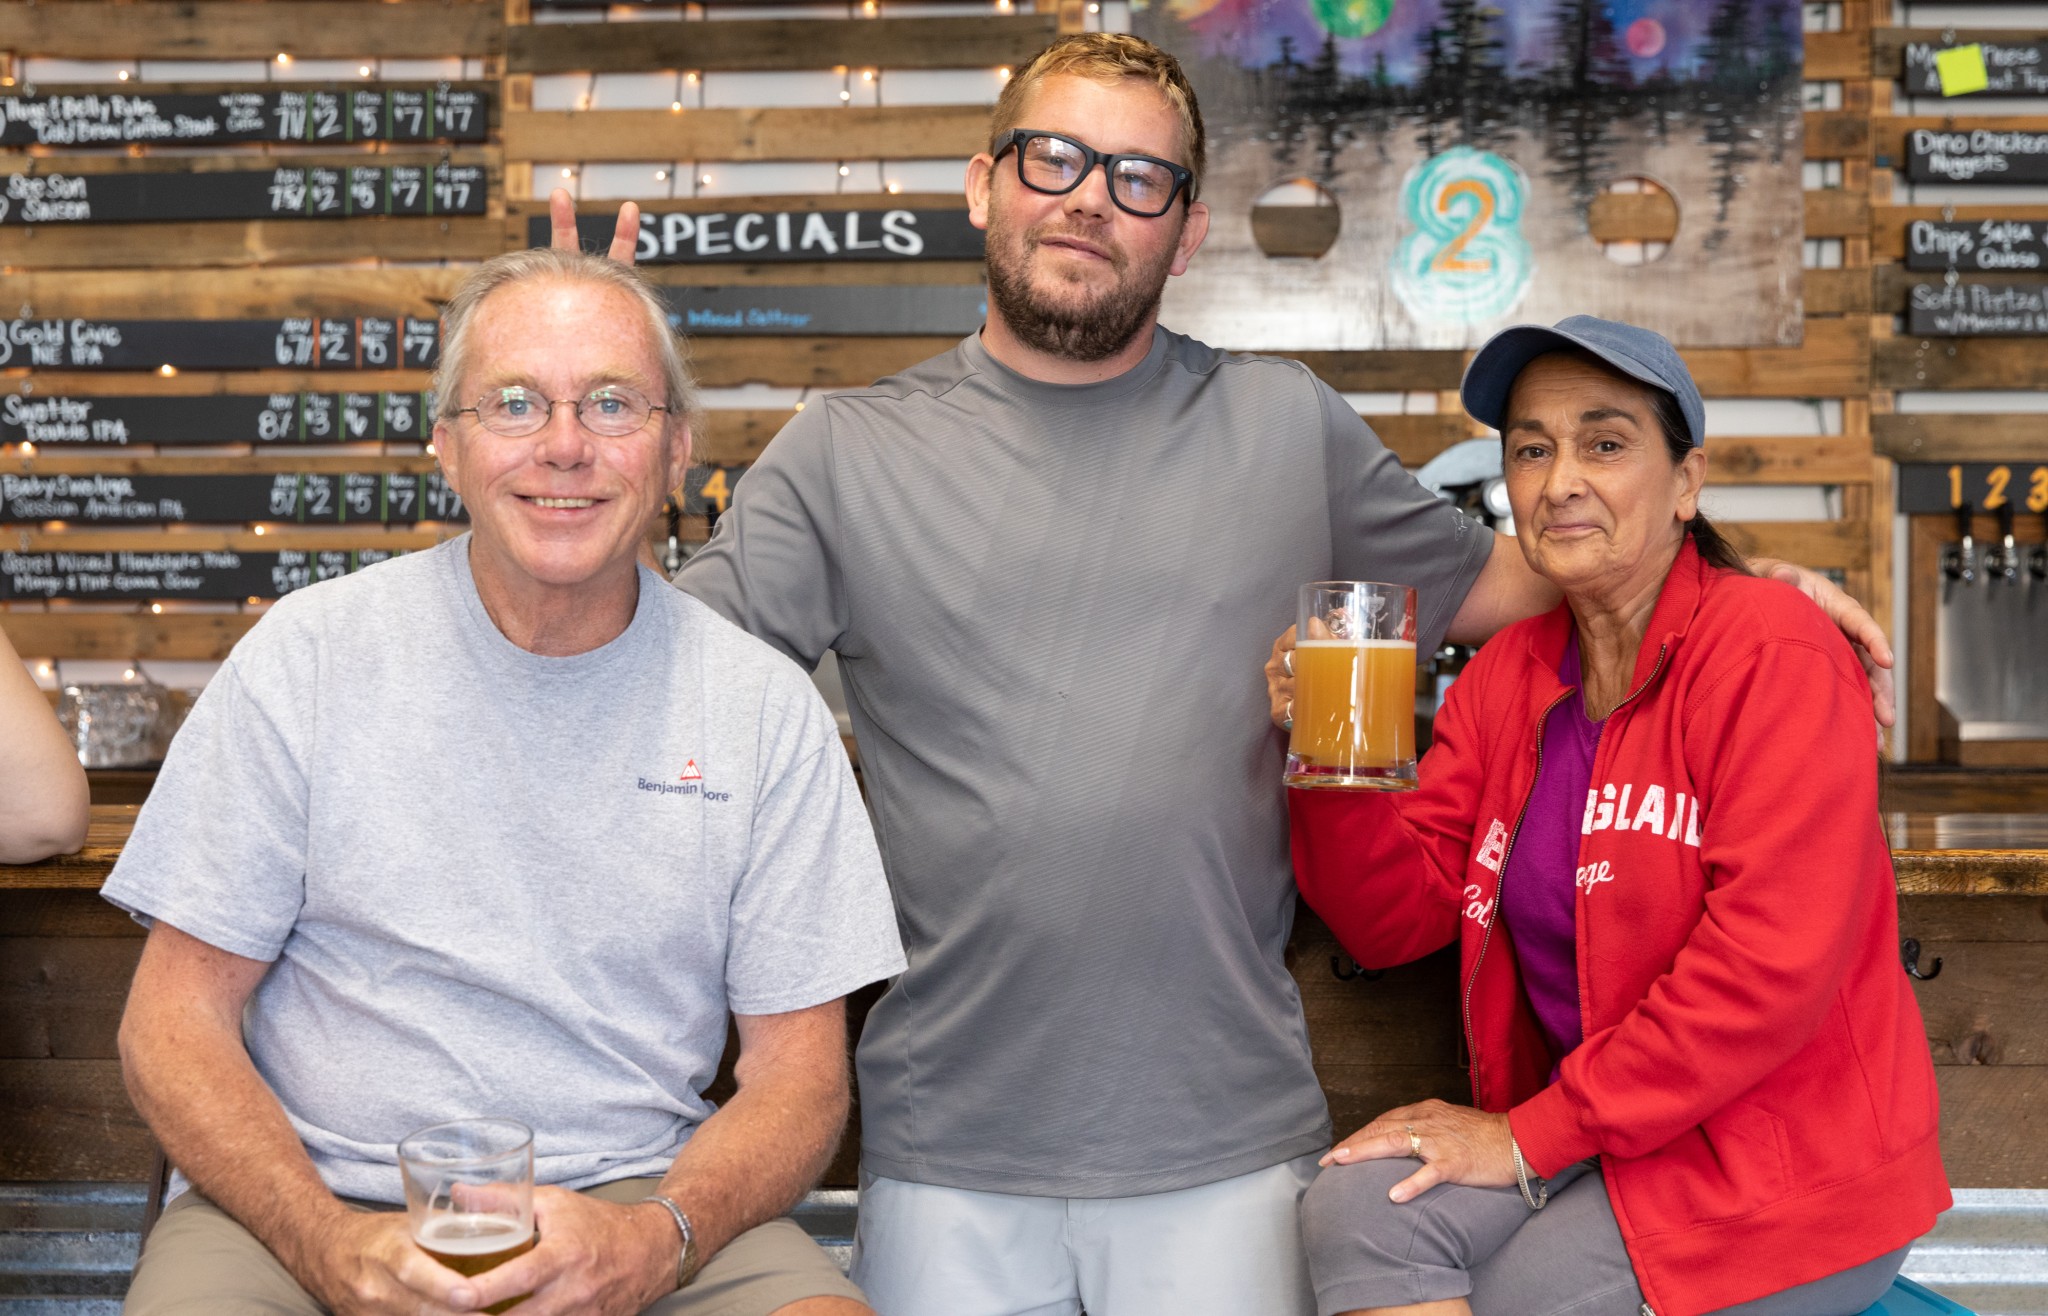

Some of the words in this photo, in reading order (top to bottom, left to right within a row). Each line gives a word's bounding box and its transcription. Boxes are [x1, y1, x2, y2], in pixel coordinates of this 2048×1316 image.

[1914, 130, 1969, 154] Dino
[1929, 153, 2009, 180] Nuggets
[634, 209, 925, 260] SPECIALS
[1431, 178, 1495, 272] 2
[1911, 220, 1975, 264] Chips
[1912, 284, 1967, 311] Soft
[9, 318, 65, 346] Gold
[71, 345, 104, 365] IPA
[92, 418, 130, 445] IPA
[701, 467, 731, 513] 4
[1948, 464, 1963, 509] 1
[1983, 465, 2012, 510] 2
[2026, 466, 2048, 513] 3
[637, 777, 697, 795] Benjamin
